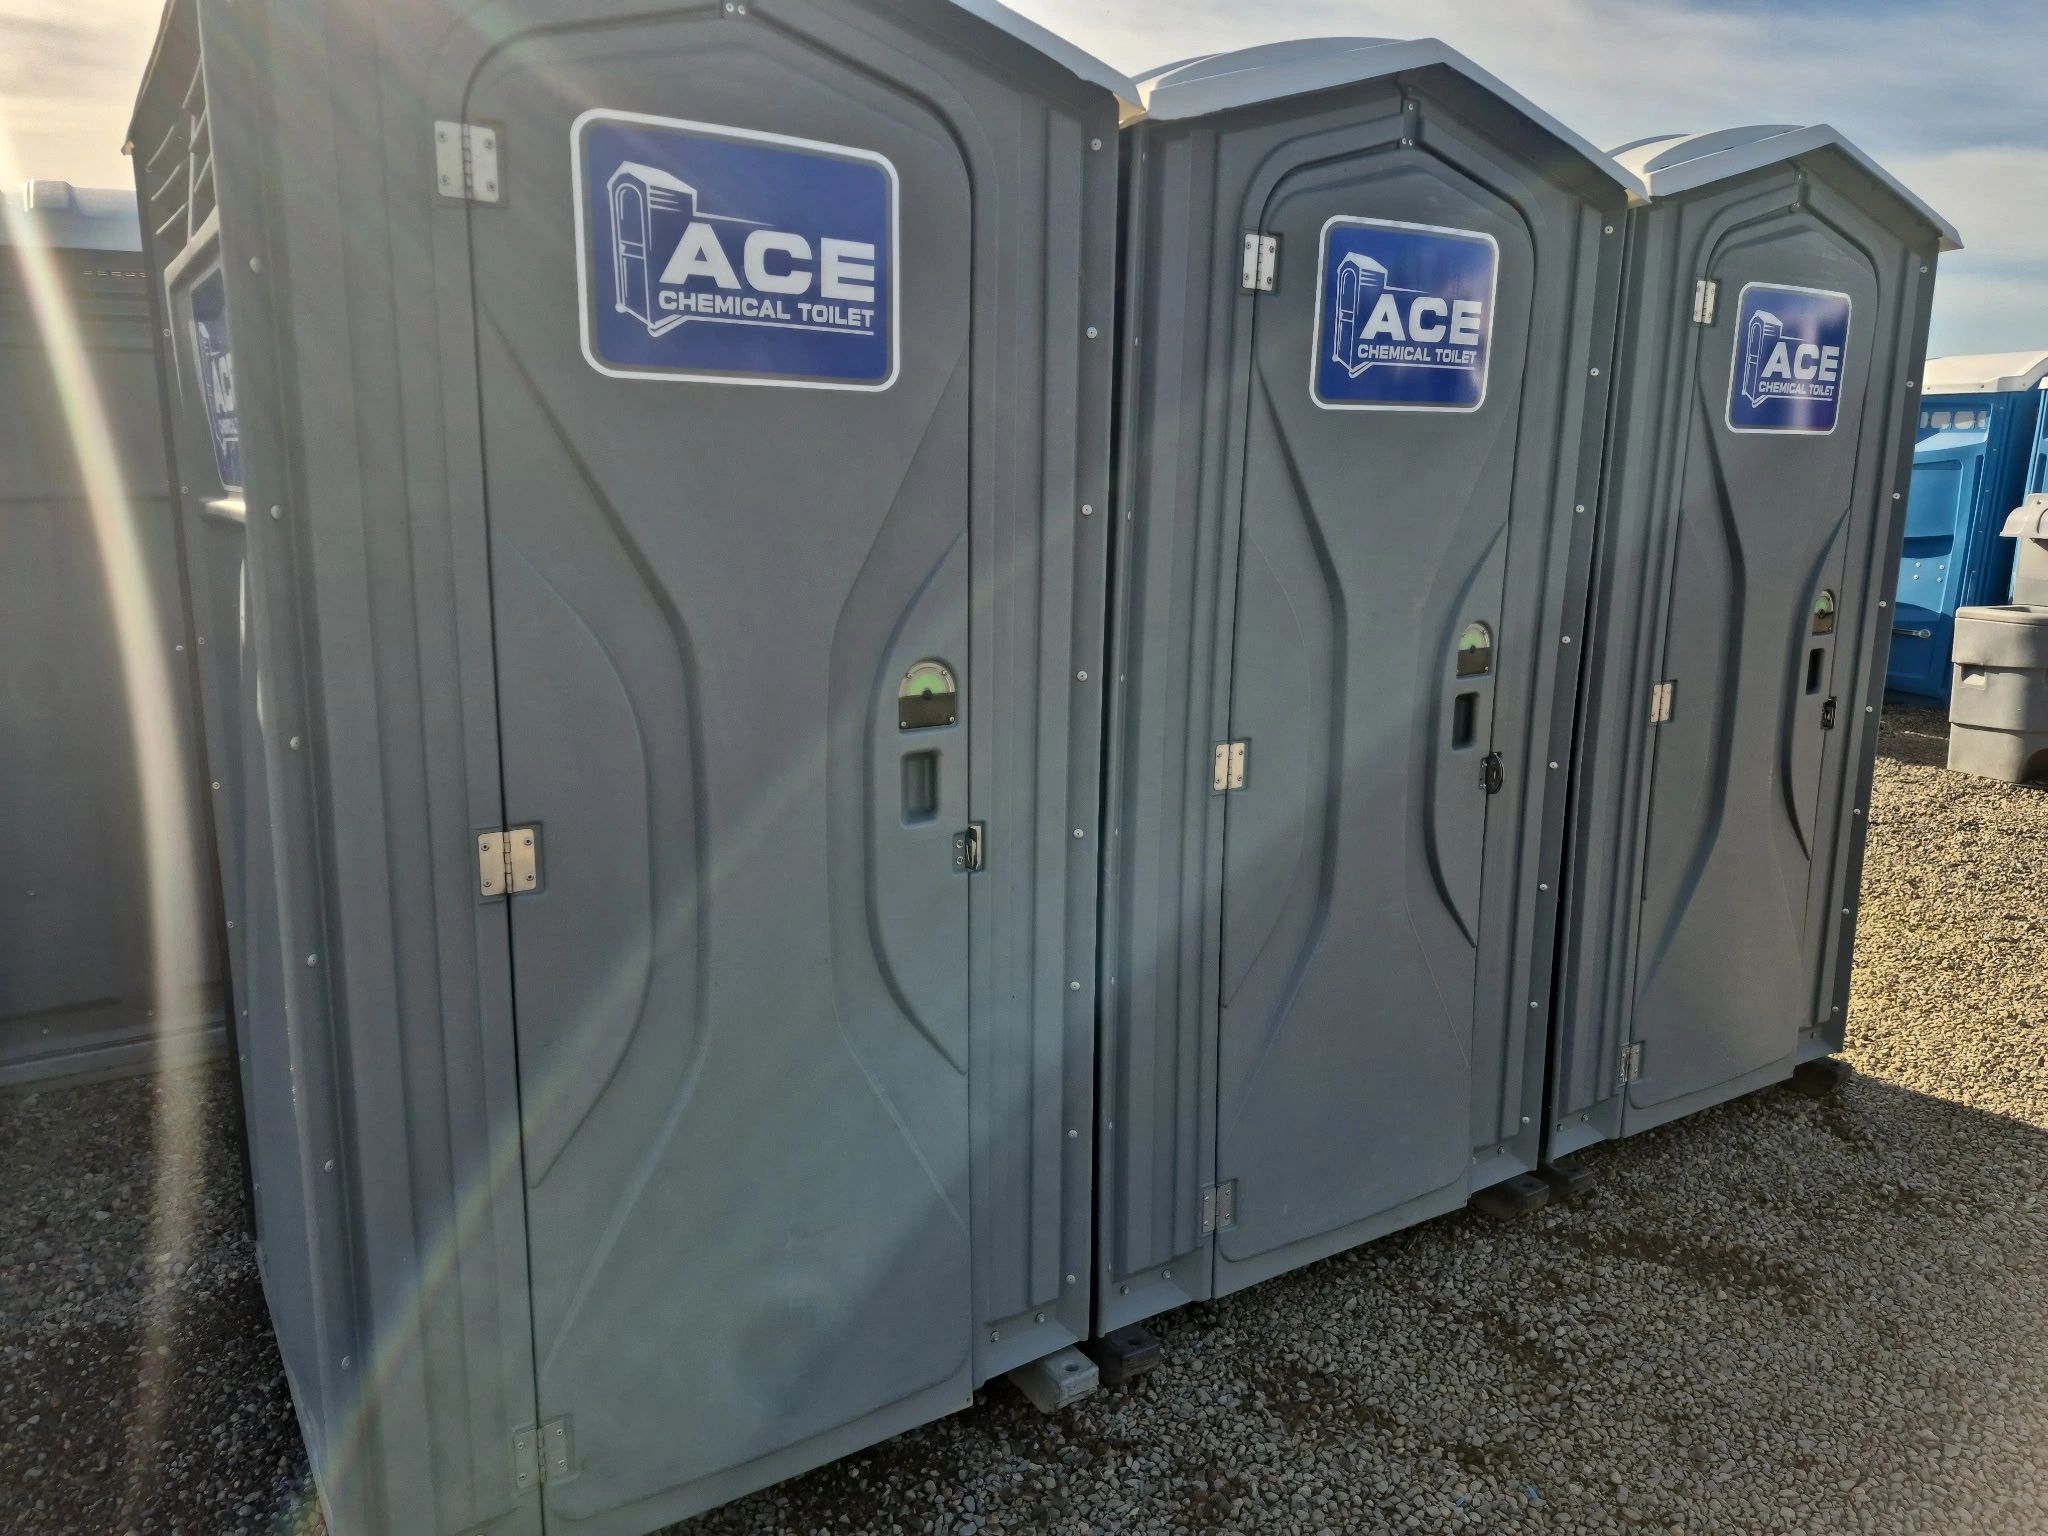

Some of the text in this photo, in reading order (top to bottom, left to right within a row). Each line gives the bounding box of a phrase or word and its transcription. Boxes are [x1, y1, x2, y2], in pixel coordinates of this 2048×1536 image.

[660, 222, 875, 303] ACE
[659, 290, 874, 327] CHEMICAL TOILET
[1360, 294, 1482, 345] ACE
[1357, 345, 1477, 364] CHEMICAL TOILET
[1761, 342, 1839, 381] ACE
[1759, 381, 1834, 395] CHEMICAL TOILET
